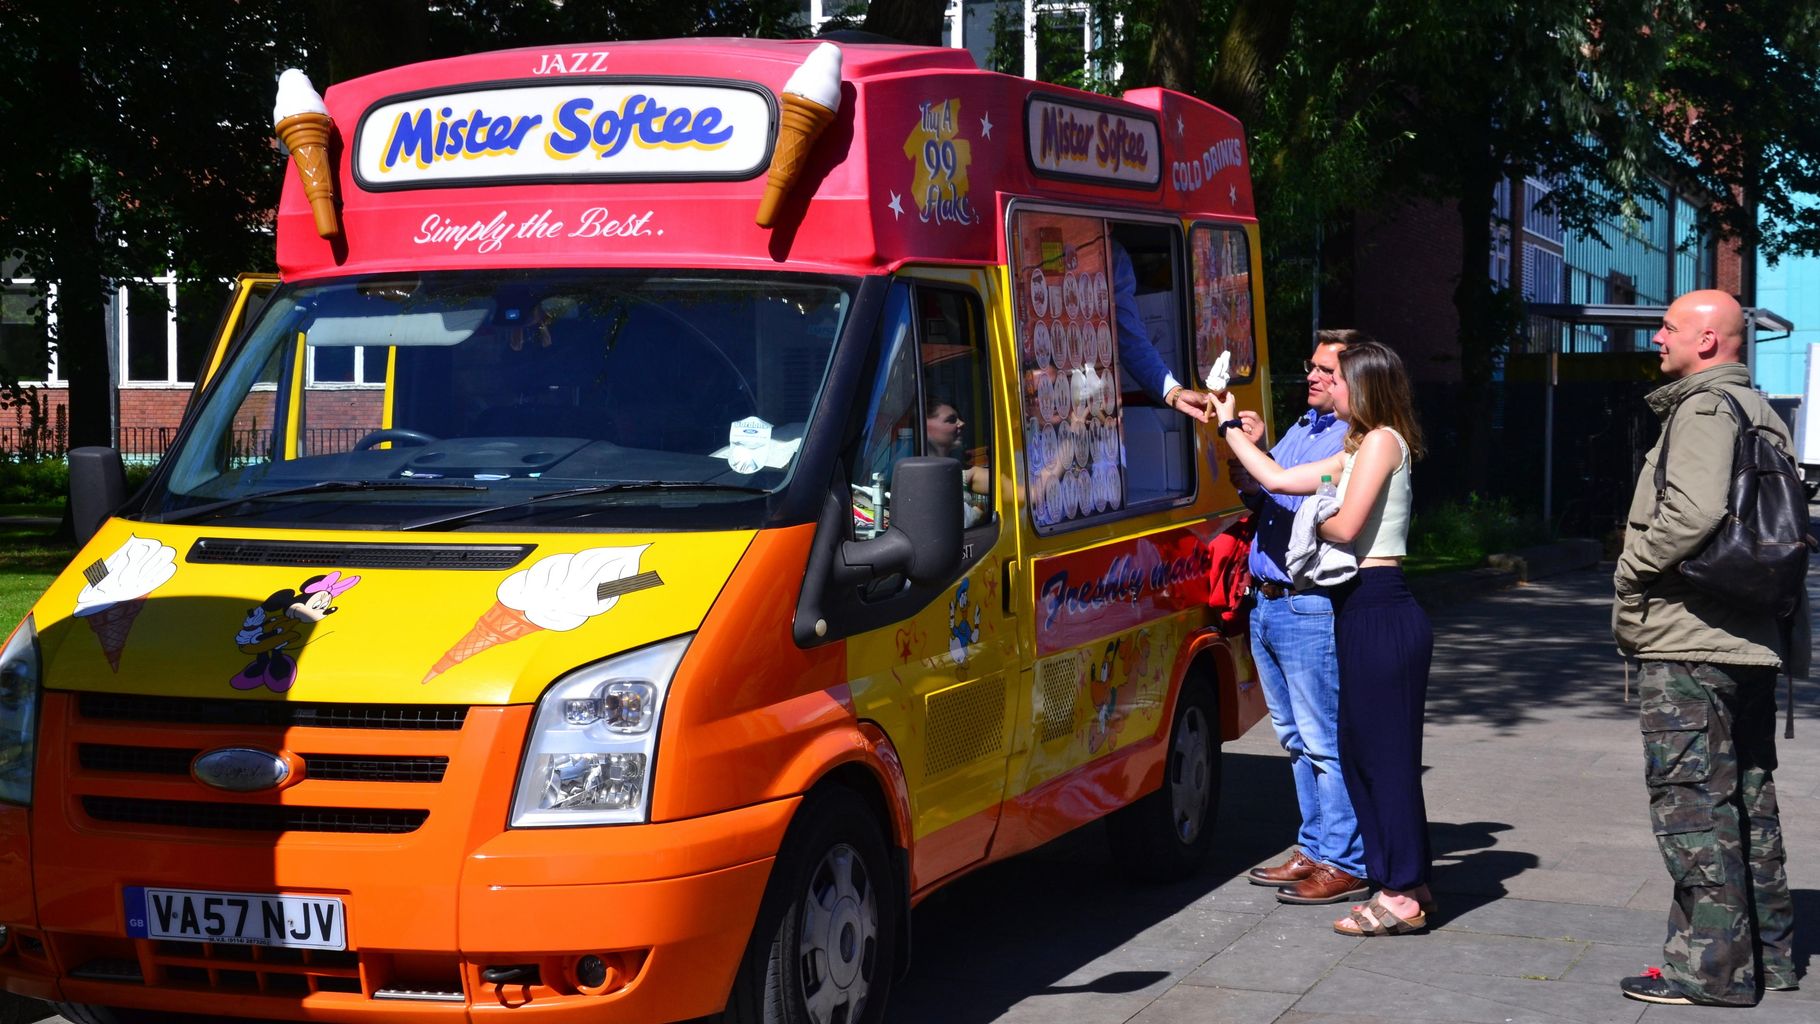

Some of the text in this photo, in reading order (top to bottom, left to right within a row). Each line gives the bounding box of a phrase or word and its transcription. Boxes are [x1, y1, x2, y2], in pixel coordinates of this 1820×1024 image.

[532, 51, 609, 75] JAZZ
[380, 94, 734, 172] Mister Softee
[941, 98, 953, 133] A
[923, 139, 958, 181] 99
[1040, 107, 1149, 173] Mister Softee
[1172, 138, 1242, 192] COLD DRINKS
[413, 210, 512, 254] Simply
[512, 208, 563, 240] the
[1040, 553, 1145, 631] Freshly
[129, 918, 145, 928] GB
[152, 894, 335, 942] VA57 NJV
